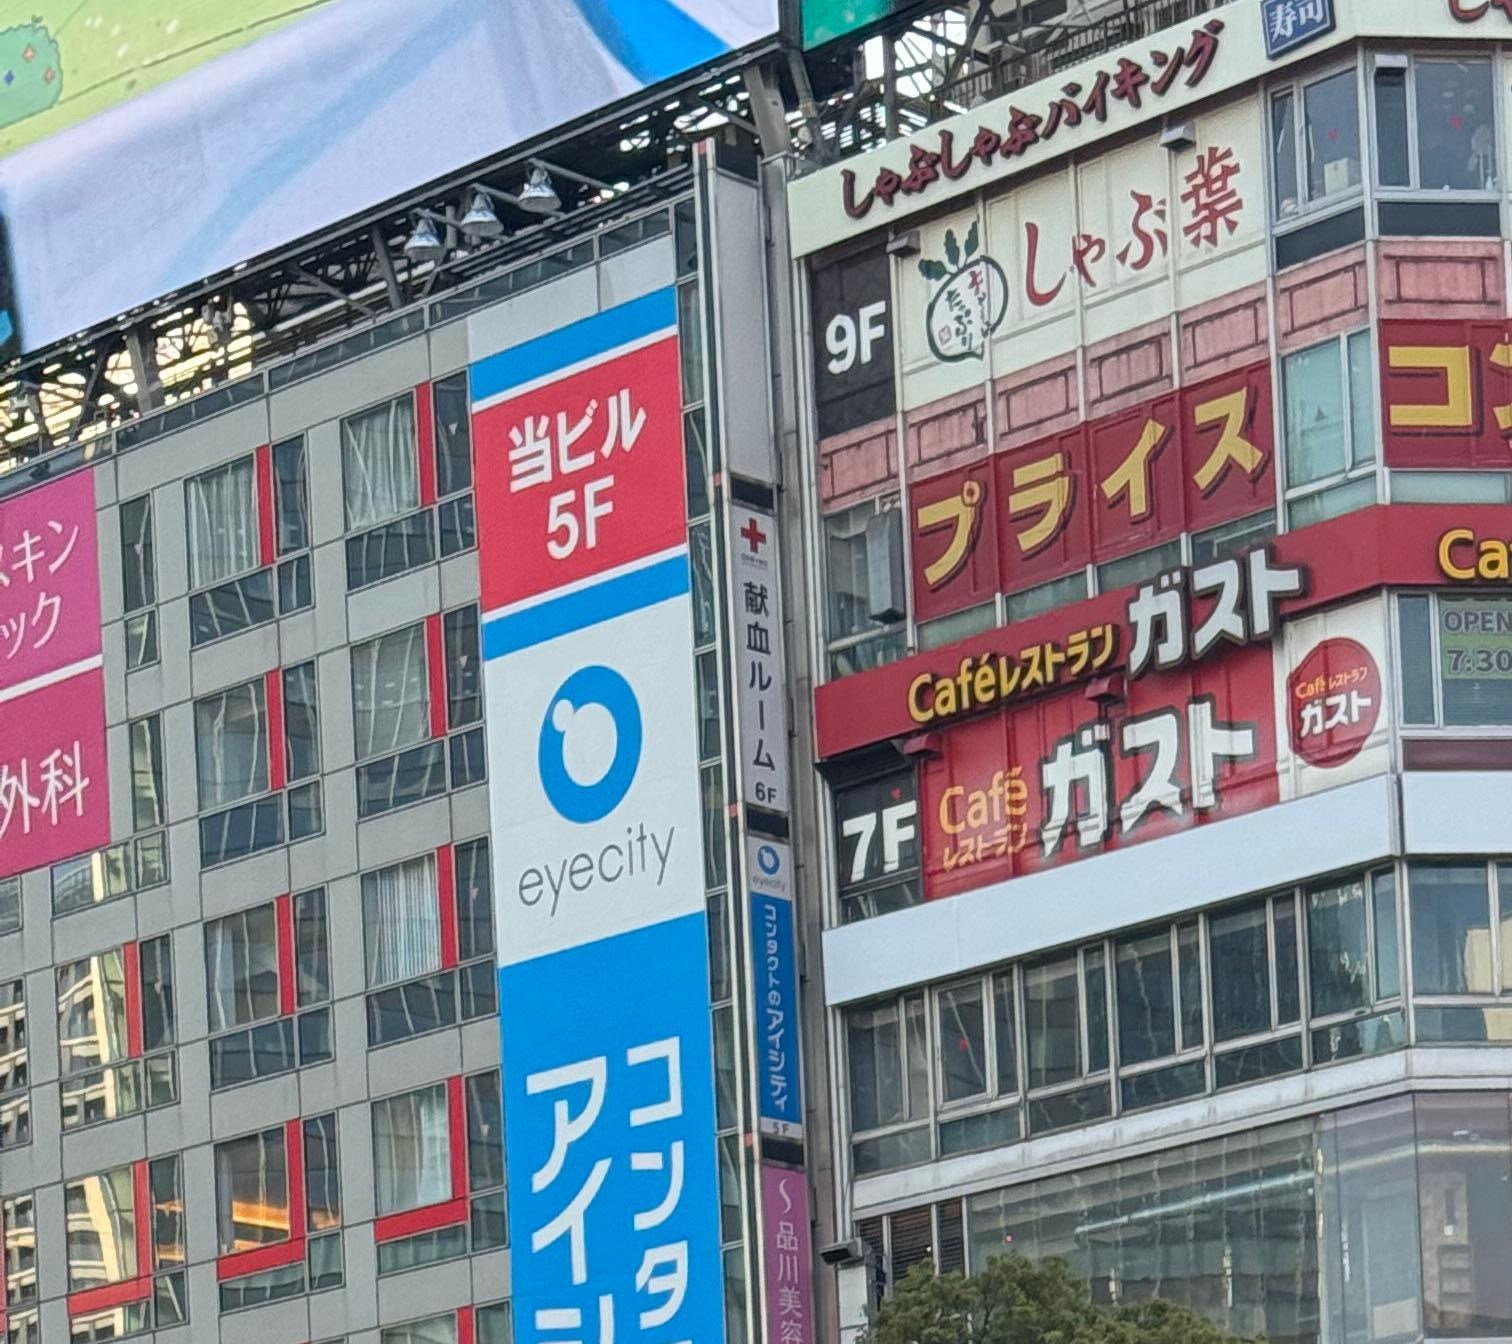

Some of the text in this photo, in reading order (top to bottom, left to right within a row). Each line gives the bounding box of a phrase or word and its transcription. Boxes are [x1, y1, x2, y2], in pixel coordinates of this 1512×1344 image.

[841, 18, 1226, 220] しゃぶしゃぶバイキング
[1023, 147, 1246, 307] しゃぶ葉
[825, 301, 887, 375] 9F
[508, 387, 649, 495] 当ビル
[916, 386, 1266, 587] プライス
[545, 475, 616, 561] 5F
[1127, 546, 1302, 676] ガスト
[743, 580, 776, 772] 献血ルーム
[1300, 689, 1372, 738] ガスト
[754, 782, 777, 804] 6F
[938, 765, 1029, 836] Café
[1041, 701, 1255, 859] ガスト
[518, 822, 675, 916] eyecity
[842, 799, 918, 883] 7F
[764, 902, 789, 1113] コンタクトのアイシティ
